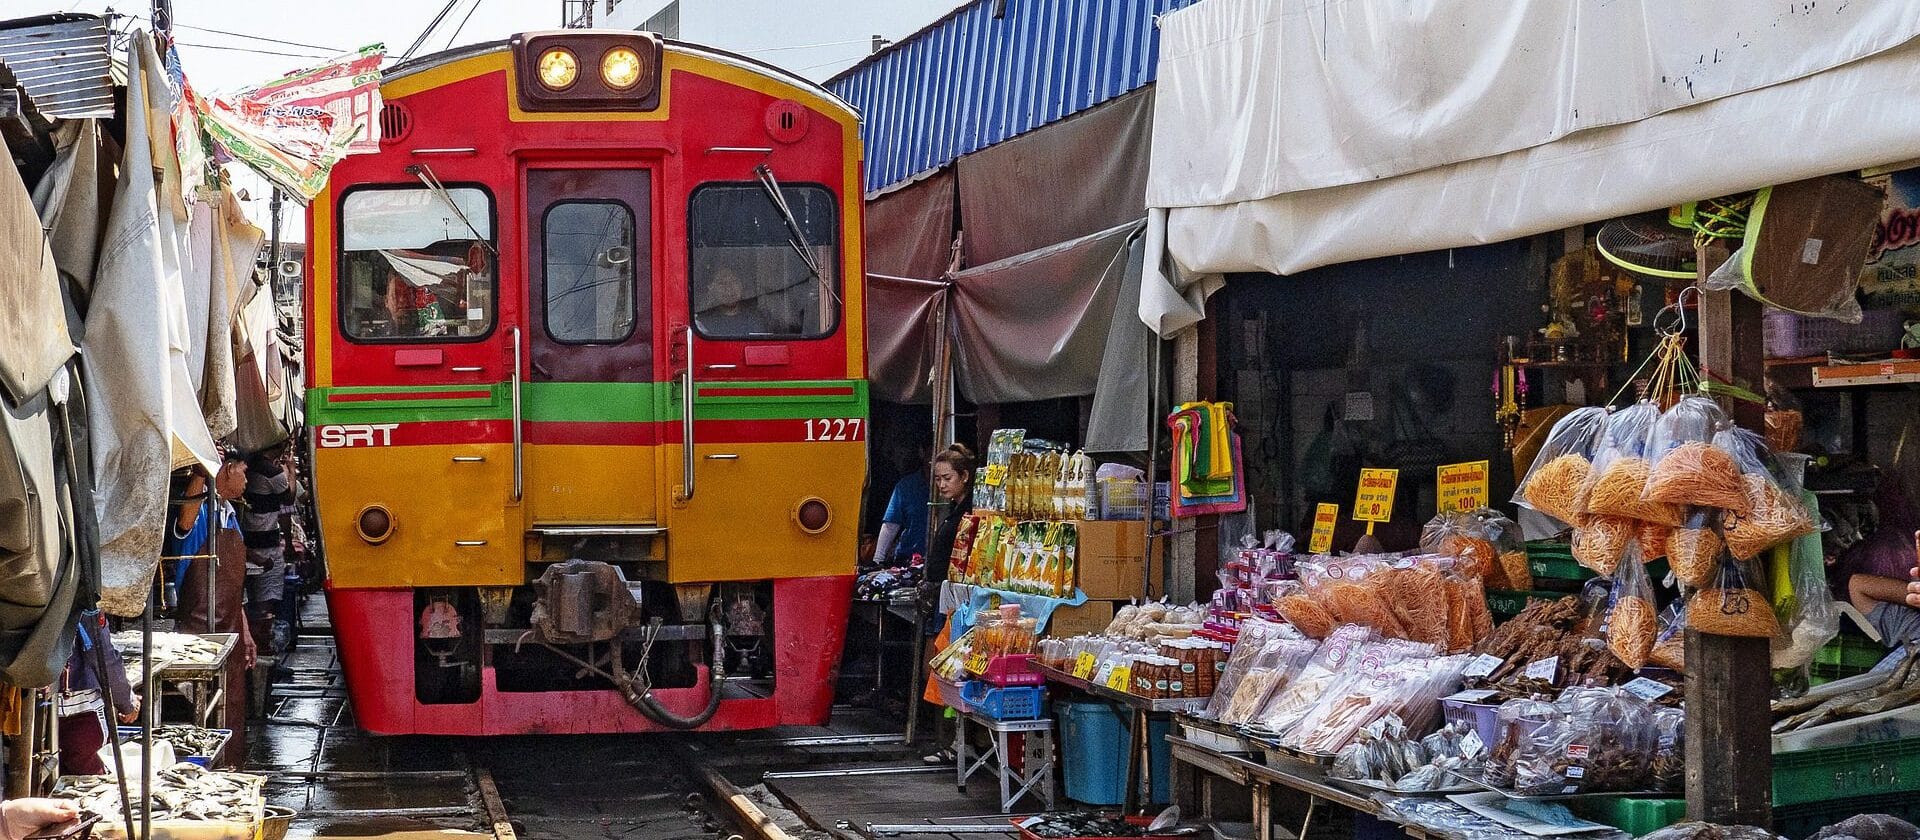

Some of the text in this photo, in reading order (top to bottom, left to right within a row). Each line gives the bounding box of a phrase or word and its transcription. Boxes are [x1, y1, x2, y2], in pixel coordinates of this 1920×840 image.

[321, 424, 399, 447] SRT
[804, 419, 861, 441] 1227
[1370, 503, 1380, 515] 80
[1458, 496, 1475, 509] 100
